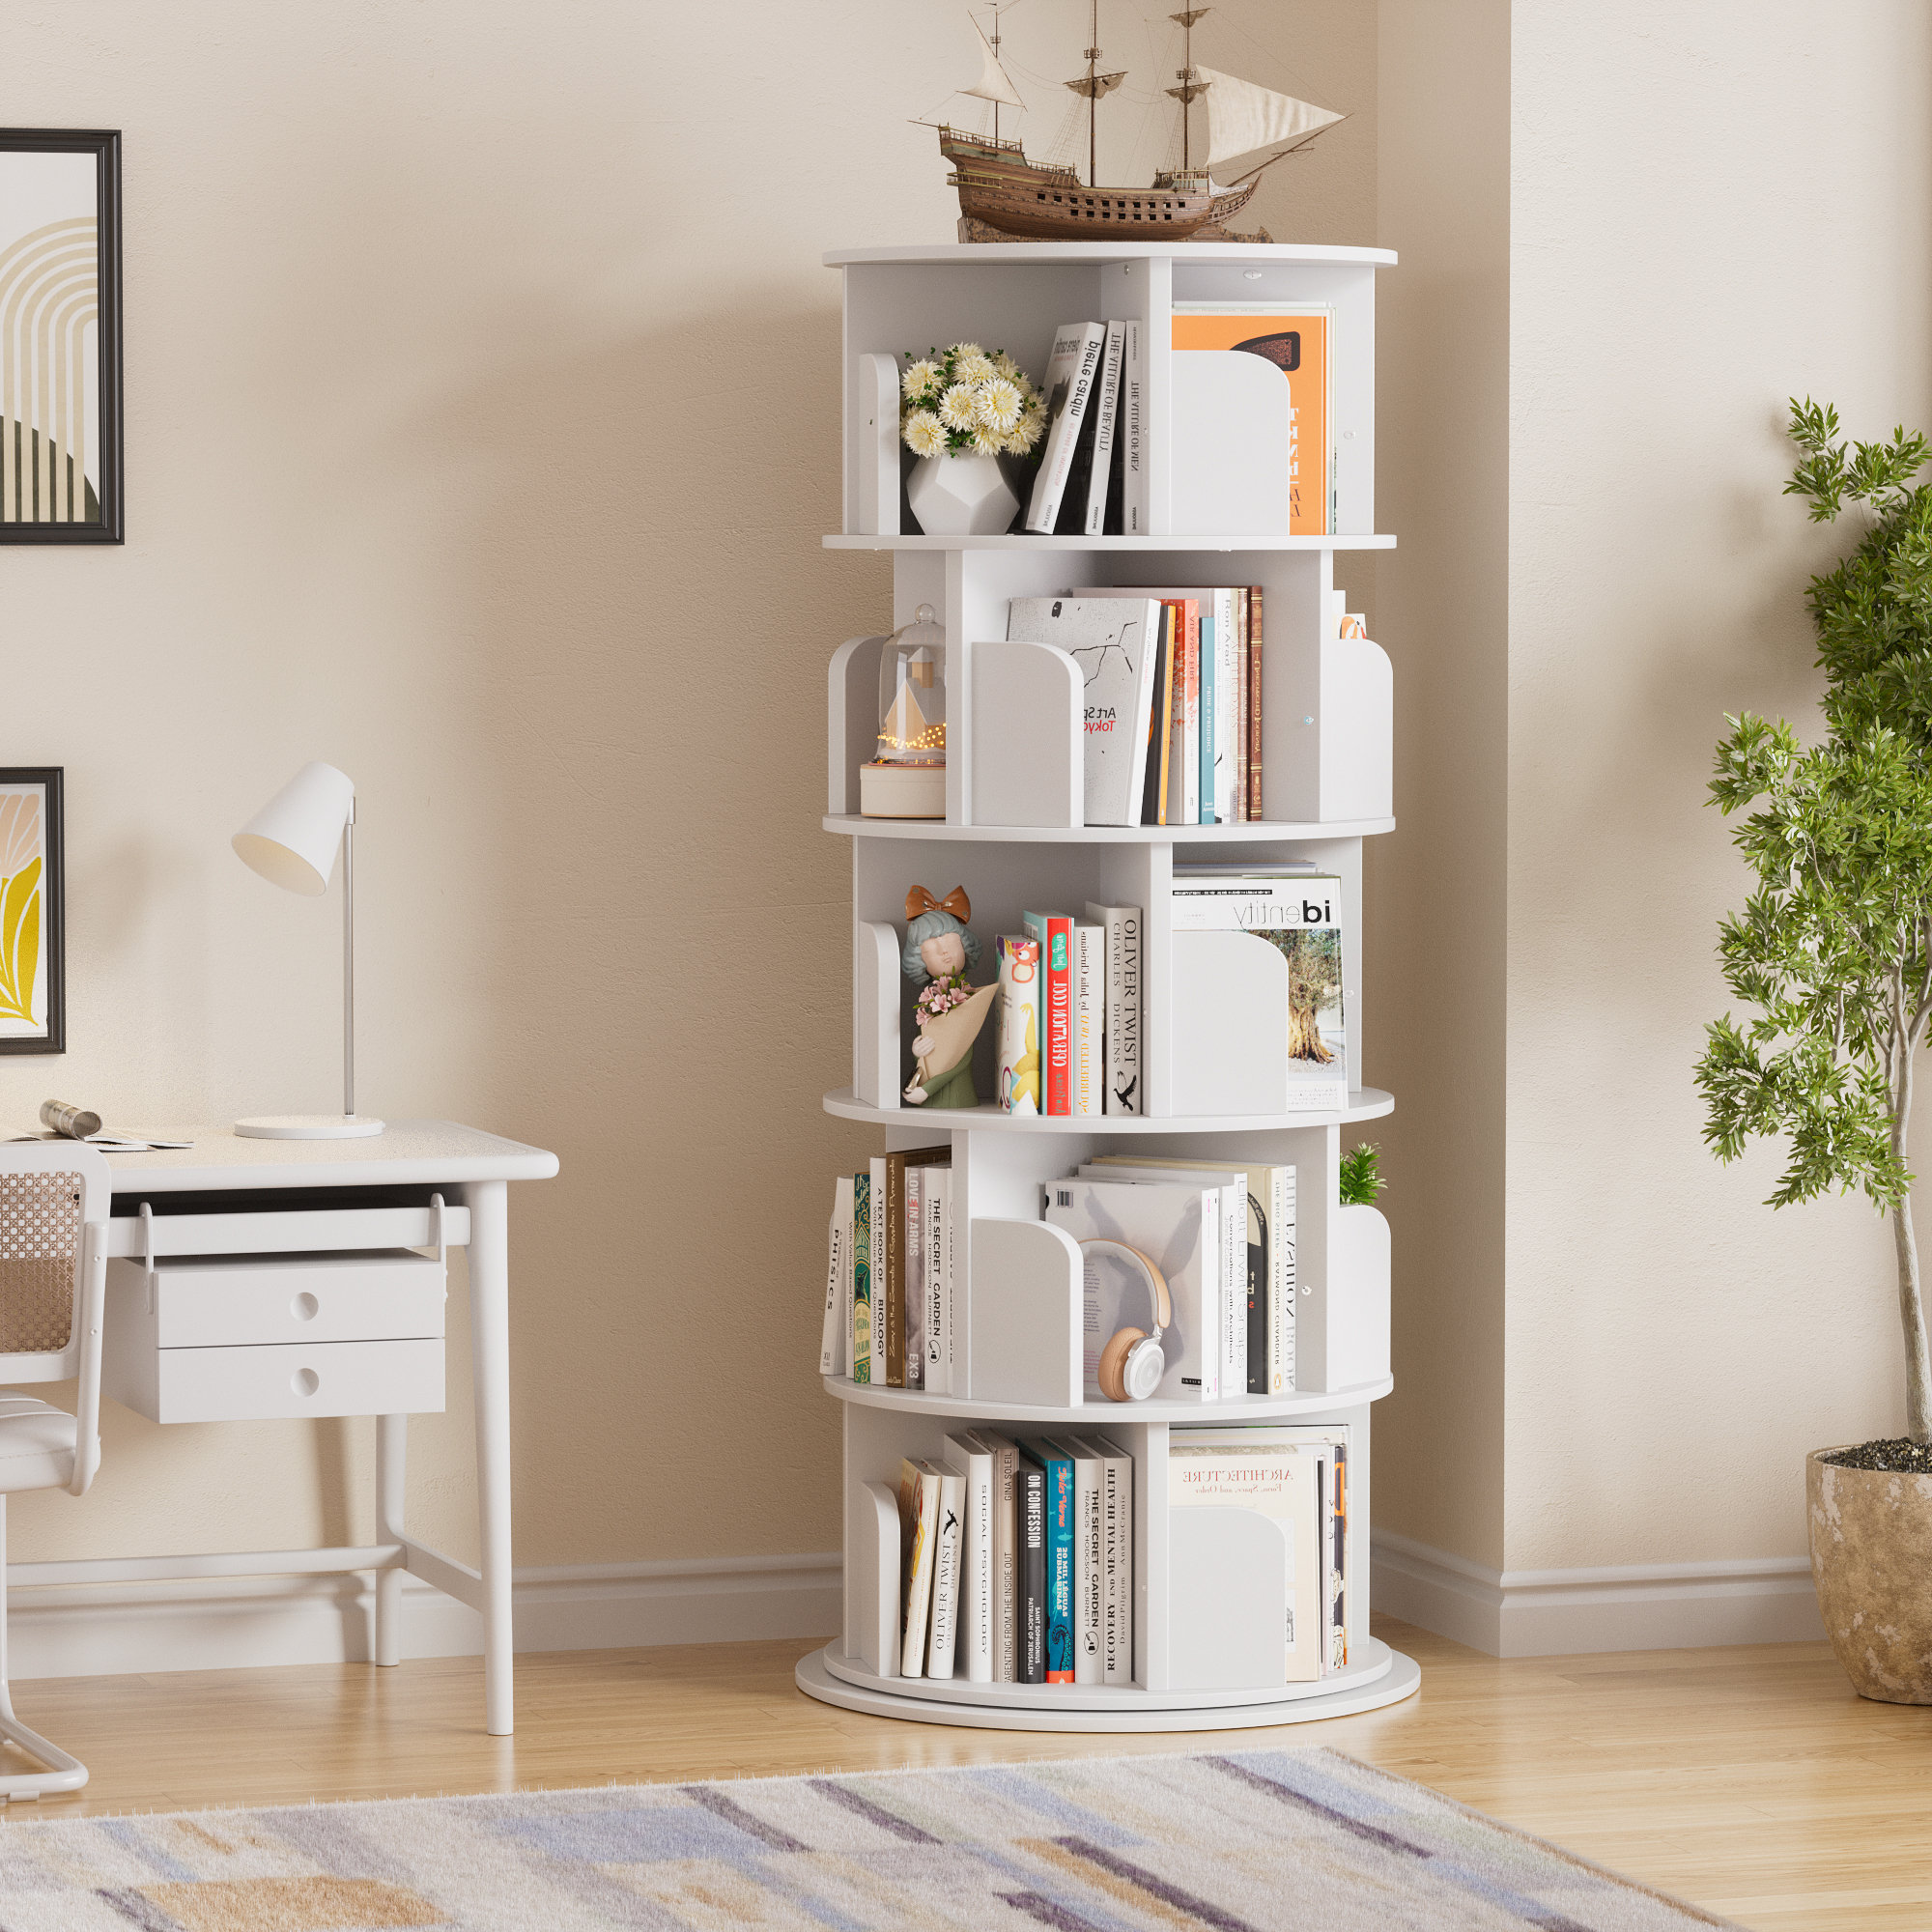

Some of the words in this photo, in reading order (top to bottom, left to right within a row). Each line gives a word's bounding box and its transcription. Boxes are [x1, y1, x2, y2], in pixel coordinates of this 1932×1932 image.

[1124, 920, 1137, 997] OLIVER
[1124, 1003, 1137, 1066] TWIST
[909, 1173, 919, 1204] LOVE
[909, 1206, 919, 1218] IN
[909, 1221, 919, 1256] ARMS
[827, 1229, 839, 1310] PHISICS
[878, 1267, 883, 1283] OF
[909, 1352, 919, 1379] EX3
[1028, 1475, 1041, 1488] ON
[1058, 1466, 1066, 1495] Jules
[1028, 1492, 1041, 1548] CONFESSION
[1059, 1495, 1067, 1527] Verne
[940, 1544, 951, 1588] TWIST
[1063, 1548, 1068, 1559] 20
[936, 1593, 947, 1650] OLIVER
[1028, 1632, 1034, 1640] OF
